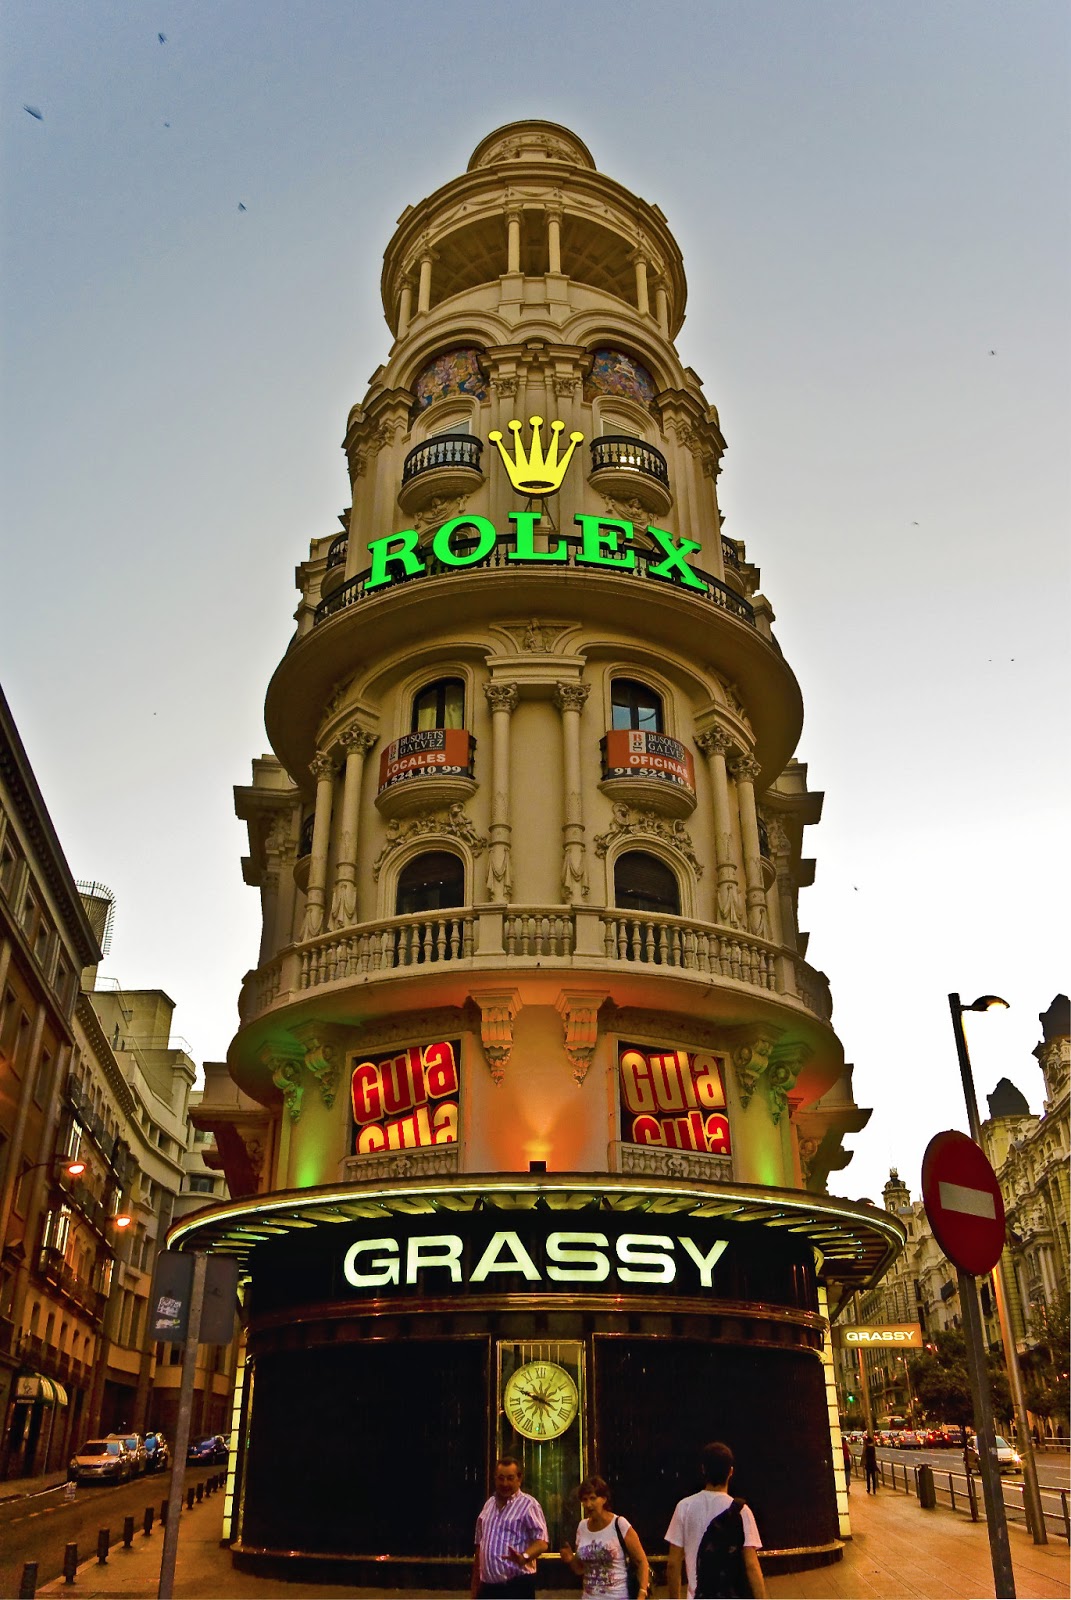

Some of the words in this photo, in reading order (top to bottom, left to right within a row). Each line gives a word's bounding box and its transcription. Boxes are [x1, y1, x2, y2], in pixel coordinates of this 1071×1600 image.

[364, 512, 708, 591] ROLEX
[400, 731, 444, 746] BUSQUETS
[400, 739, 443, 754] GALVEZ
[387, 754, 446, 777] LOCALES
[420, 765, 437, 774] 10
[442, 765, 462, 774] 99
[614, 767, 633, 776] 91
[639, 767, 666, 779] 524
[629, 755, 688, 778] OFICINAS
[351, 1041, 458, 1125] Gula
[620, 1049, 728, 1114] Gula
[343, 1231, 730, 1288] GRASSY
[845, 1331, 915, 1341] GRASSY
